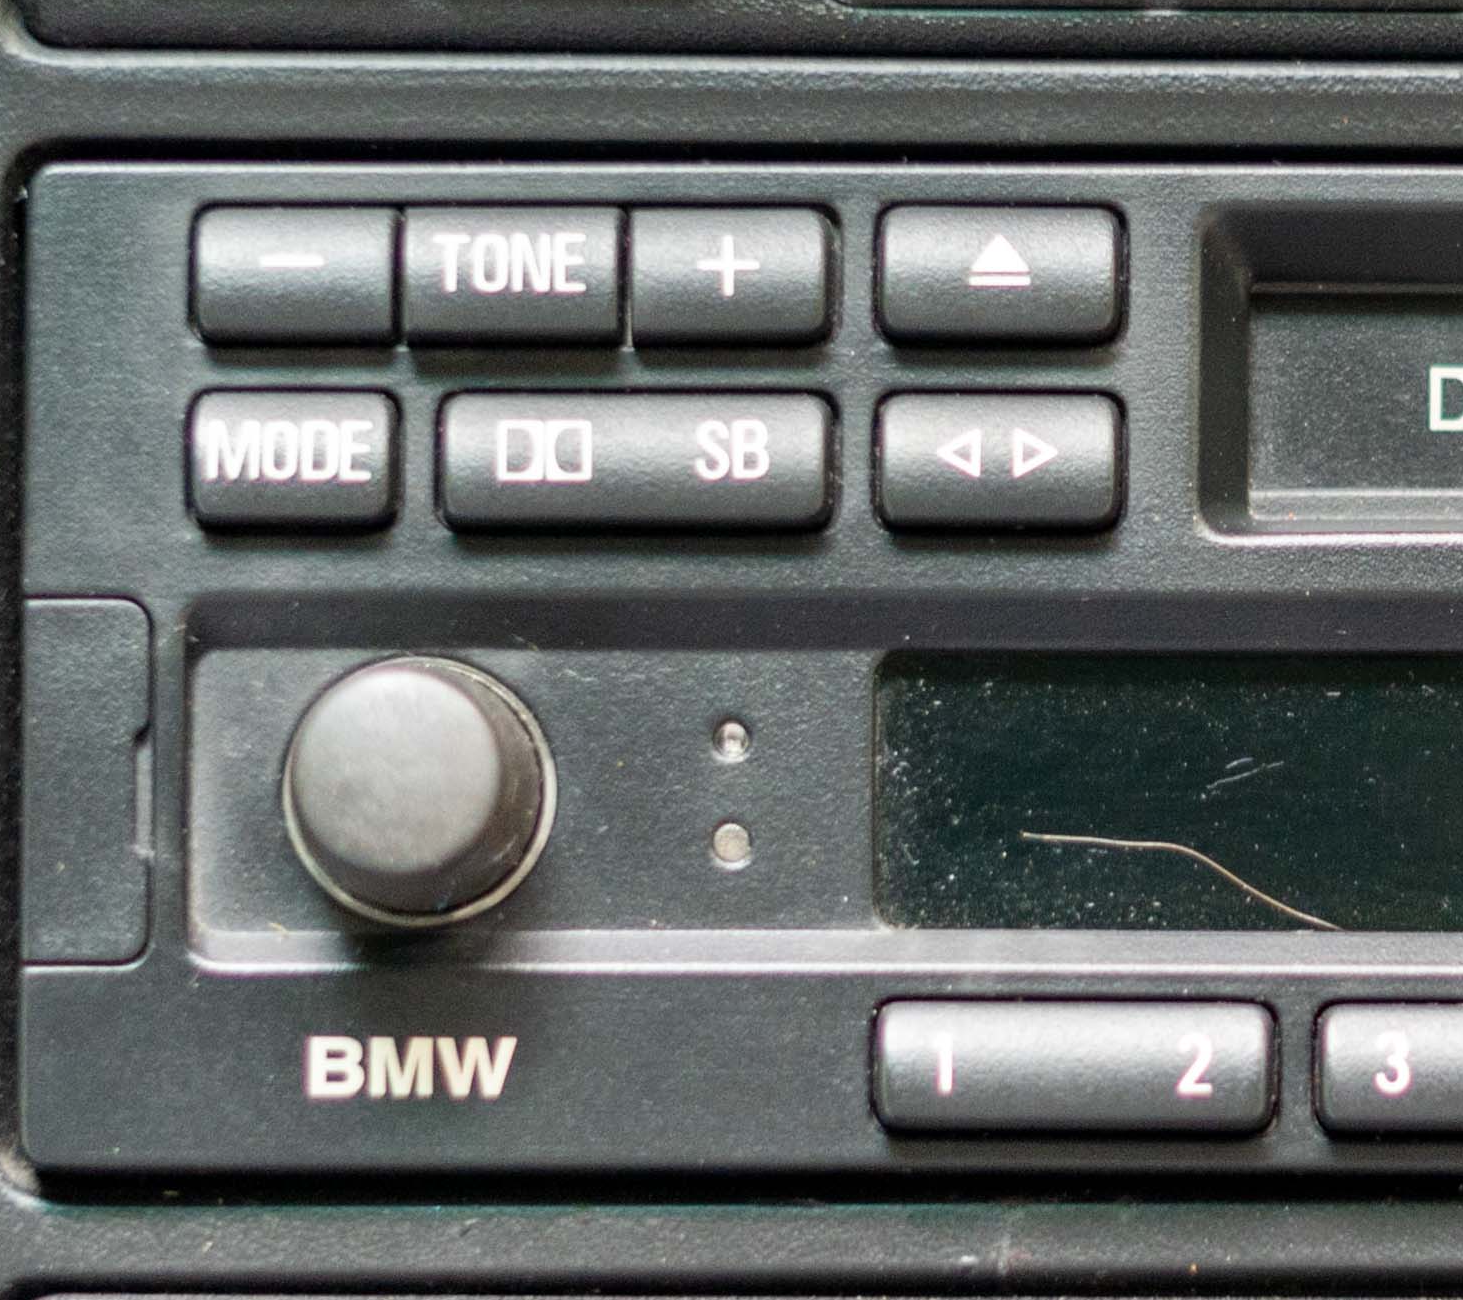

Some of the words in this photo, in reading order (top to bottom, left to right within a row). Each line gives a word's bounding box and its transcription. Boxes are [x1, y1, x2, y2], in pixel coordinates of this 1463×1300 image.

[434, 231, 587, 294] TONE
[204, 419, 374, 483] MODE
[694, 419, 771, 482] SB
[305, 1034, 518, 1099] BMW
[934, 1033, 954, 1095] 1
[1177, 1039, 1216, 1097] 2
[1374, 1038, 1412, 1095] 3
